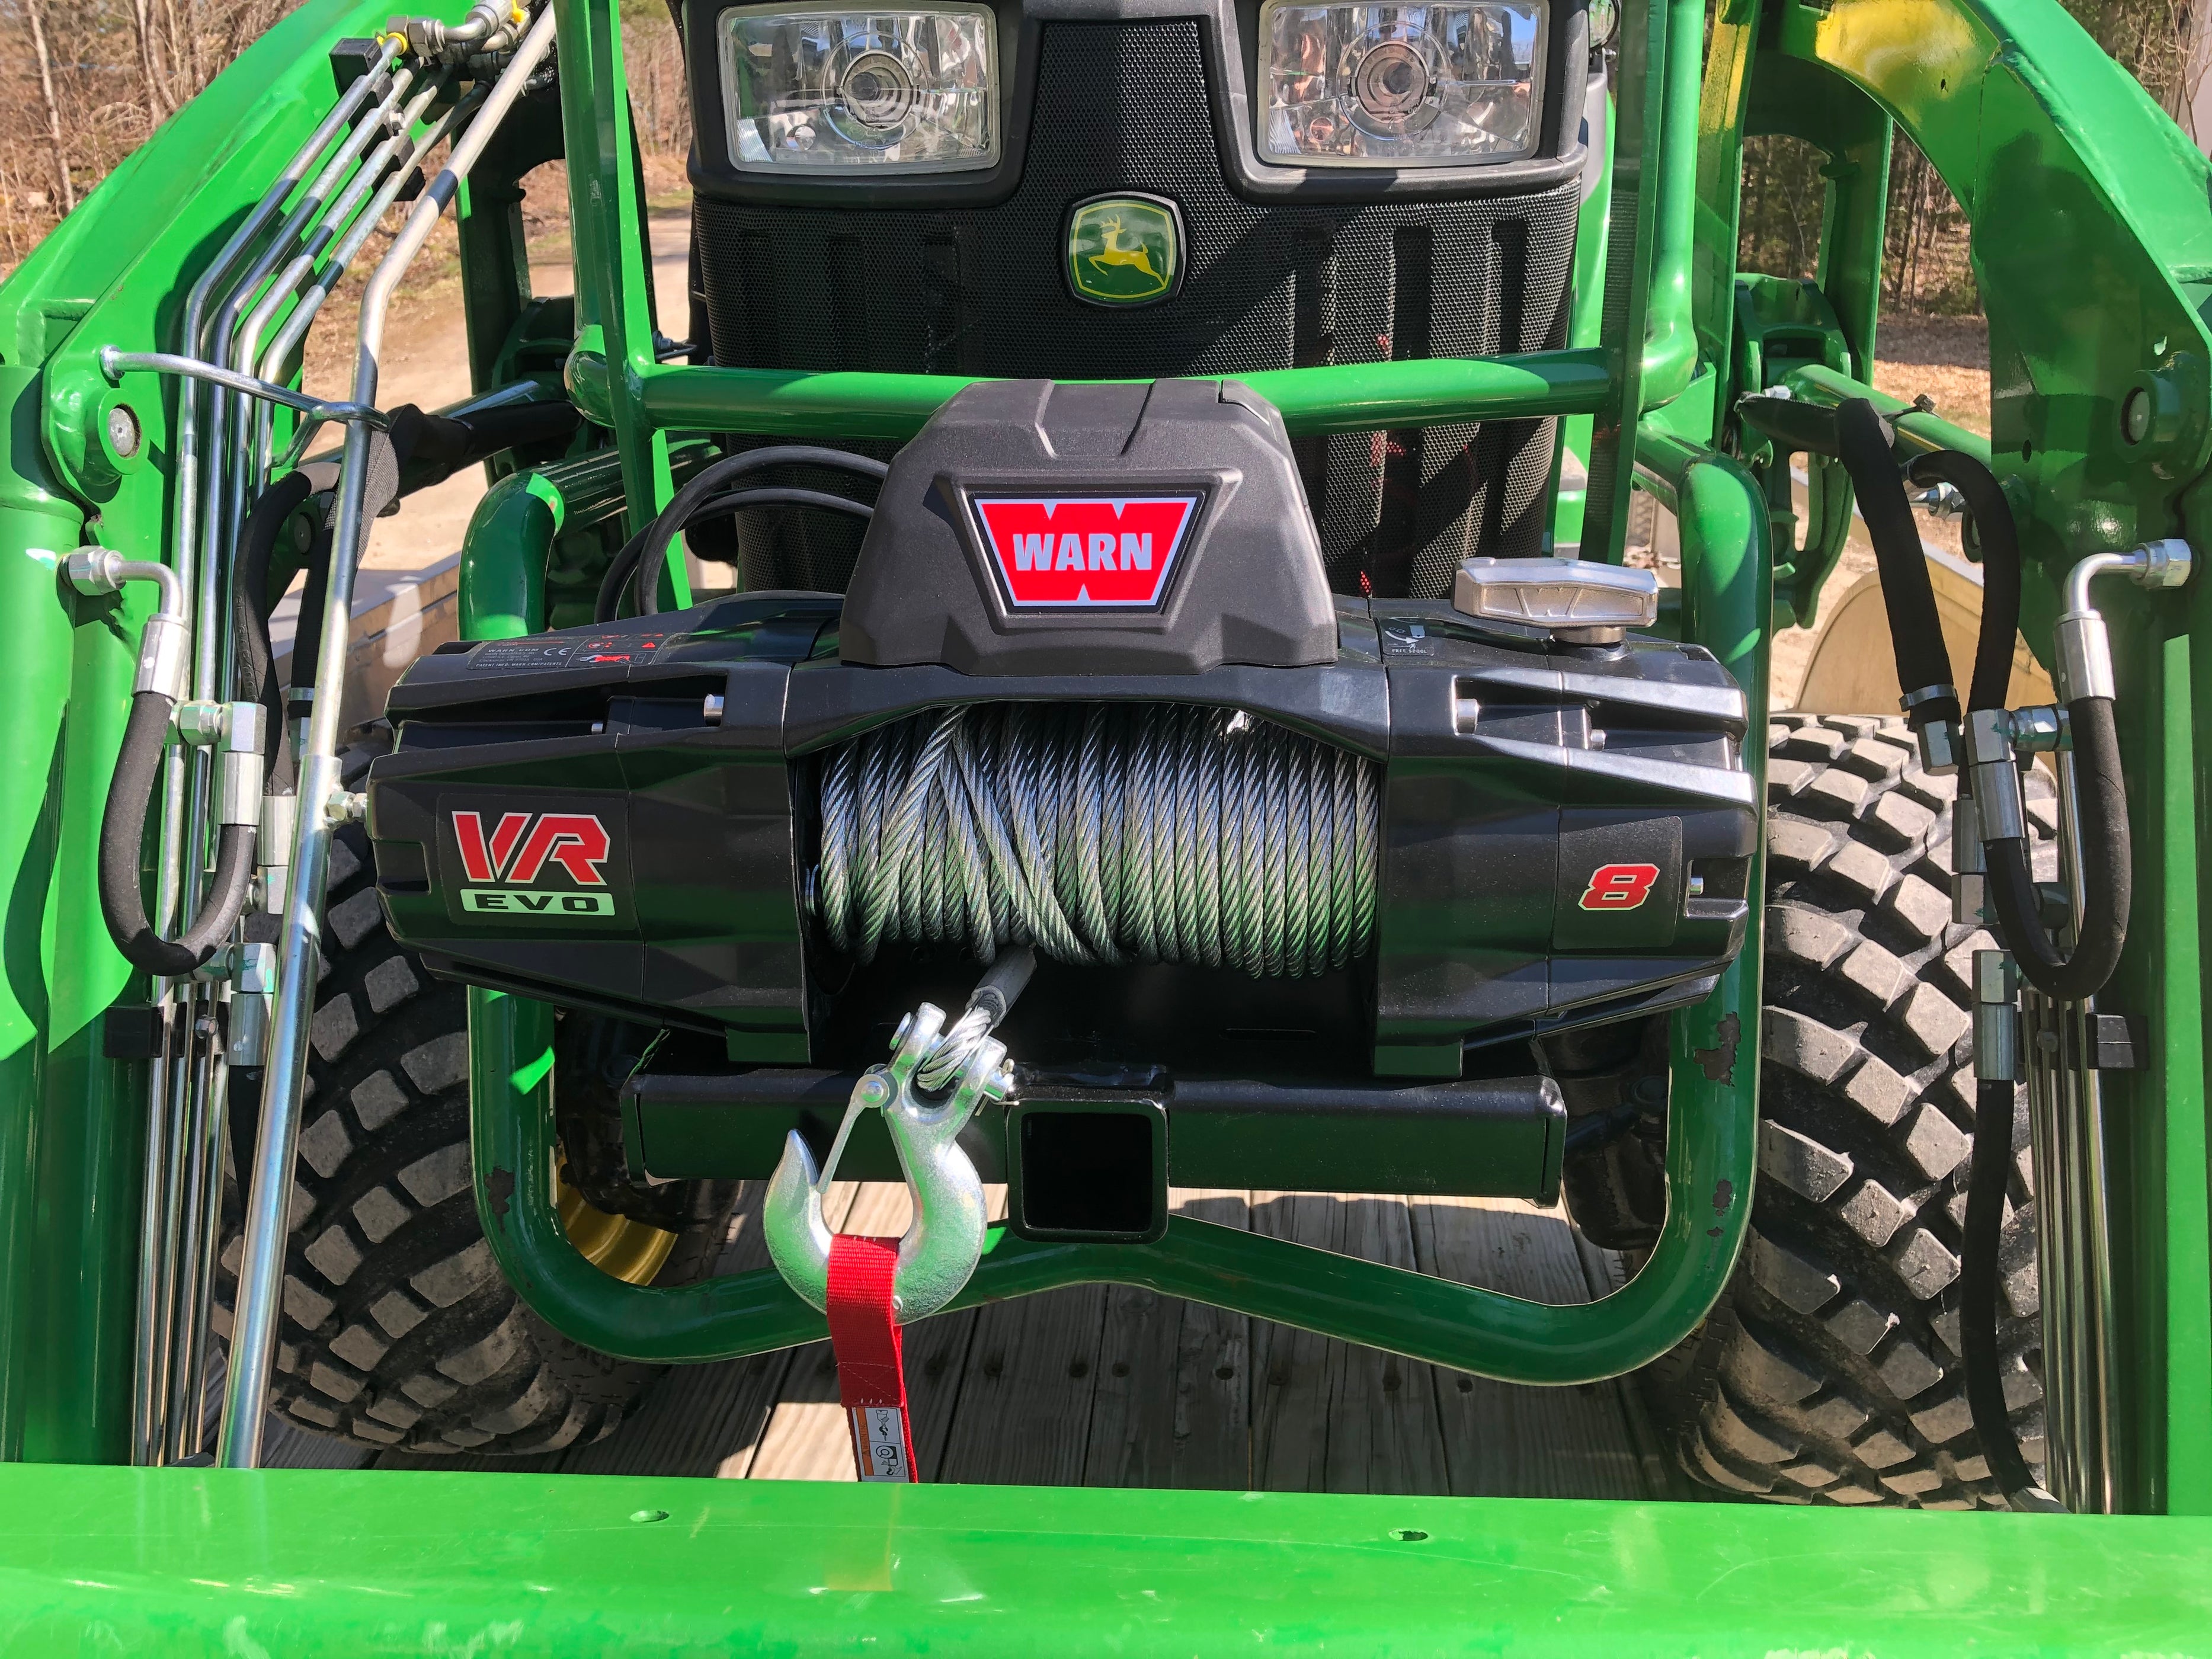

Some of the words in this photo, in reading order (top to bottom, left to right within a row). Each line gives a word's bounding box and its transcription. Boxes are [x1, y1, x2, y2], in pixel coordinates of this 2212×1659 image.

[1013, 533, 1152, 571] WARN
[543, 648, 572, 656] CE
[452, 811, 611, 886] VR
[474, 893, 600, 912] EVO
[1578, 863, 1660, 911] 8
